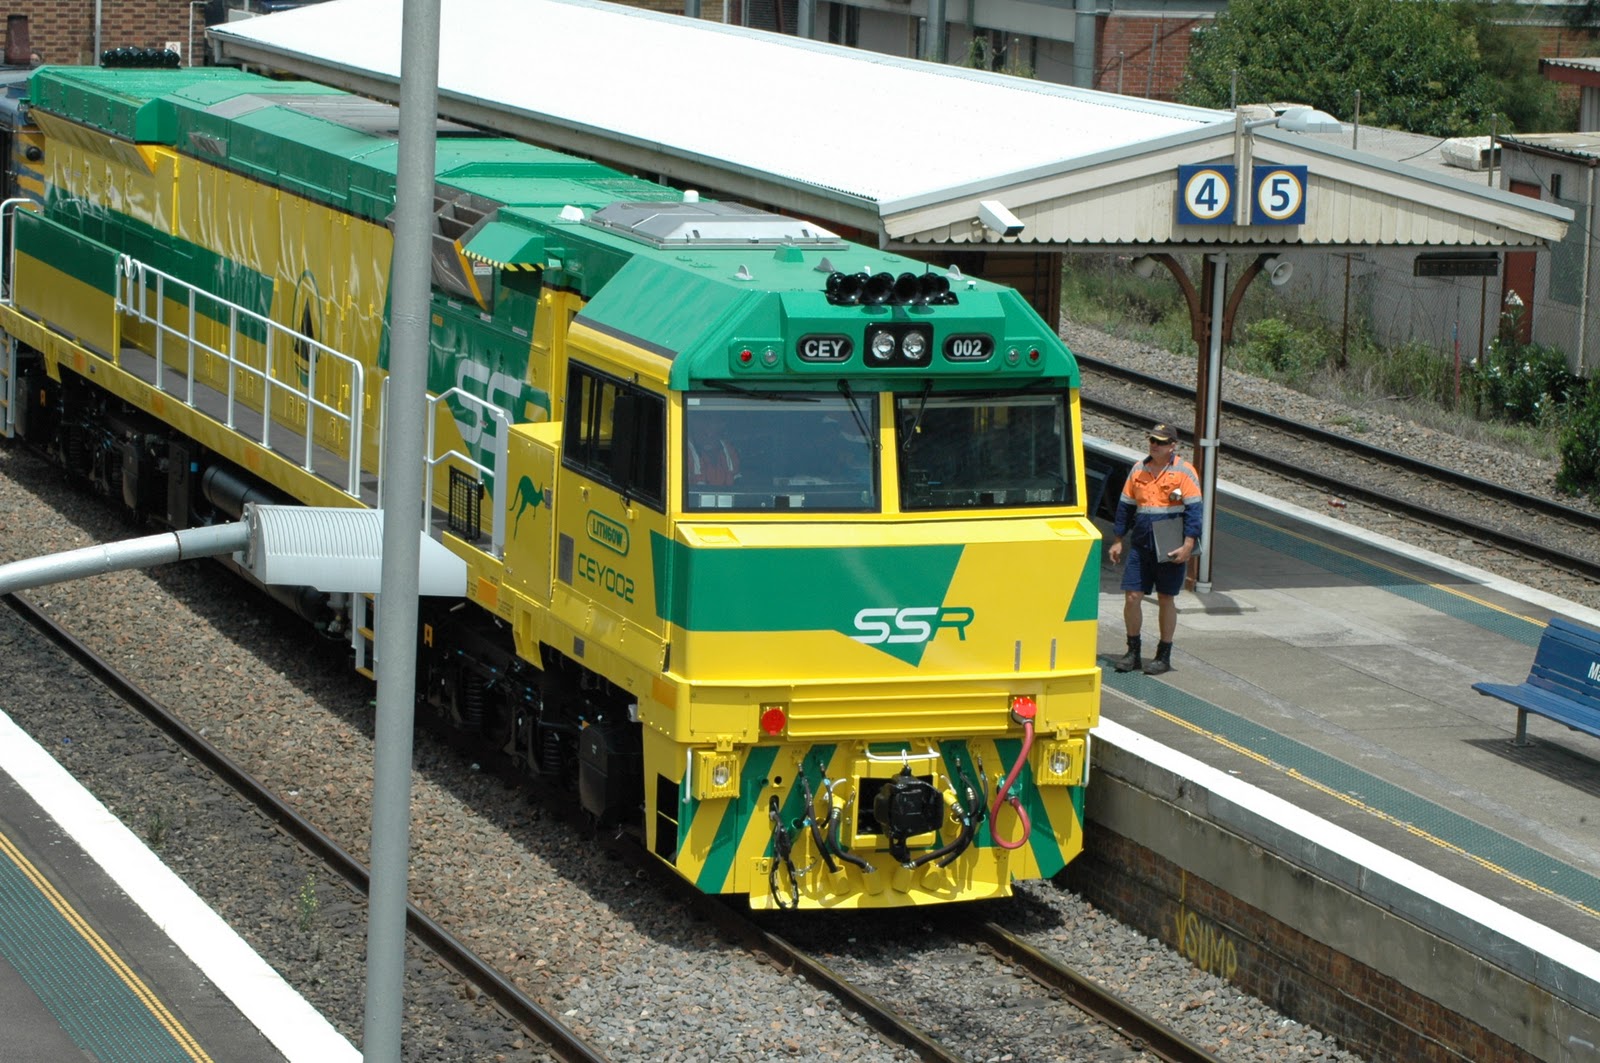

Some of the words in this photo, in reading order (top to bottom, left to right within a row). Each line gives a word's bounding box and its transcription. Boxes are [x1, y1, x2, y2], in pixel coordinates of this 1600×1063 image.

[1194, 178, 1218, 212] 4
[1270, 178, 1290, 212] 5
[804, 339, 844, 357] CEY
[953, 339, 982, 356] 002
[592, 518, 623, 547] LITHGOW
[578, 552, 634, 604] CEY002
[849, 606, 975, 644] SSR
